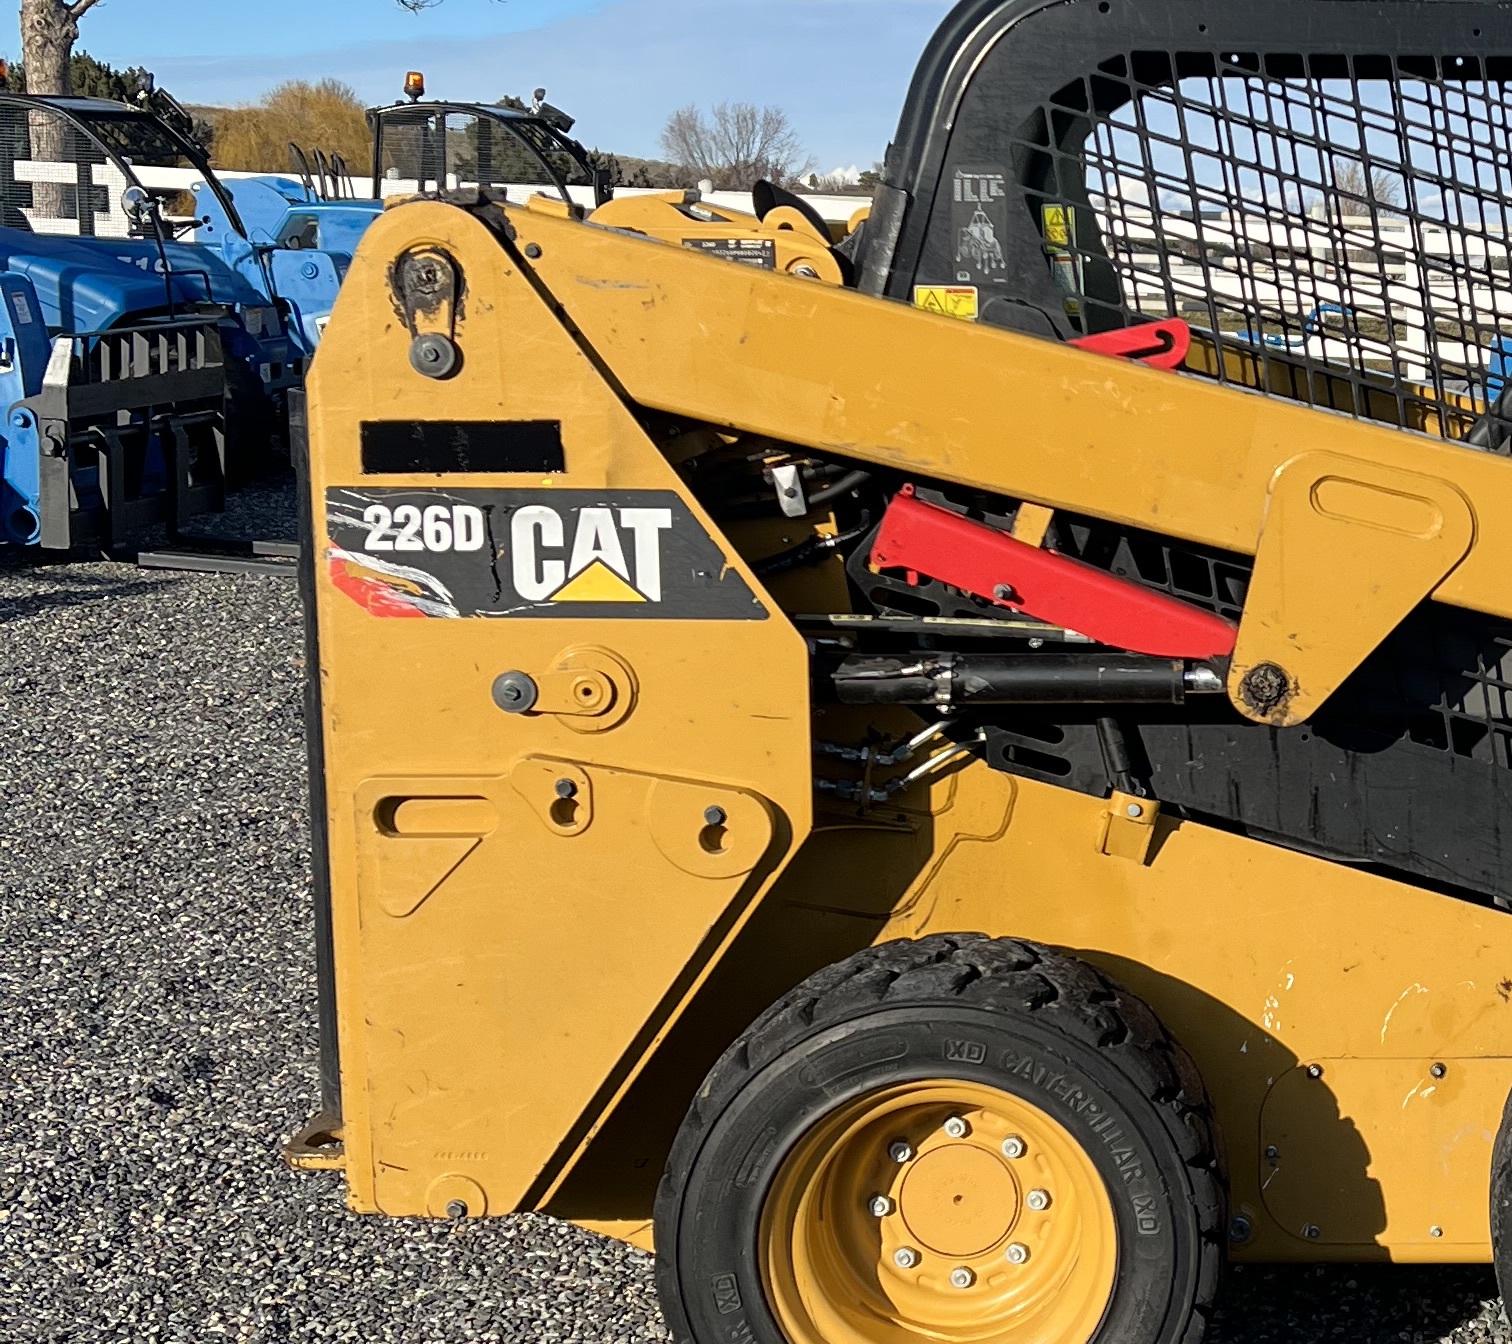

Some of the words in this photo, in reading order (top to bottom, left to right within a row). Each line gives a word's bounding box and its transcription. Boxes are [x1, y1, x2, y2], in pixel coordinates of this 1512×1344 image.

[362, 504, 485, 552] 226D
[511, 504, 673, 602] CAT
[947, 1040, 986, 1063] XD
[1001, 1049, 1147, 1185] CATERPILLAR
[1132, 1195, 1160, 1233] XD
[712, 1274, 741, 1313] XD
